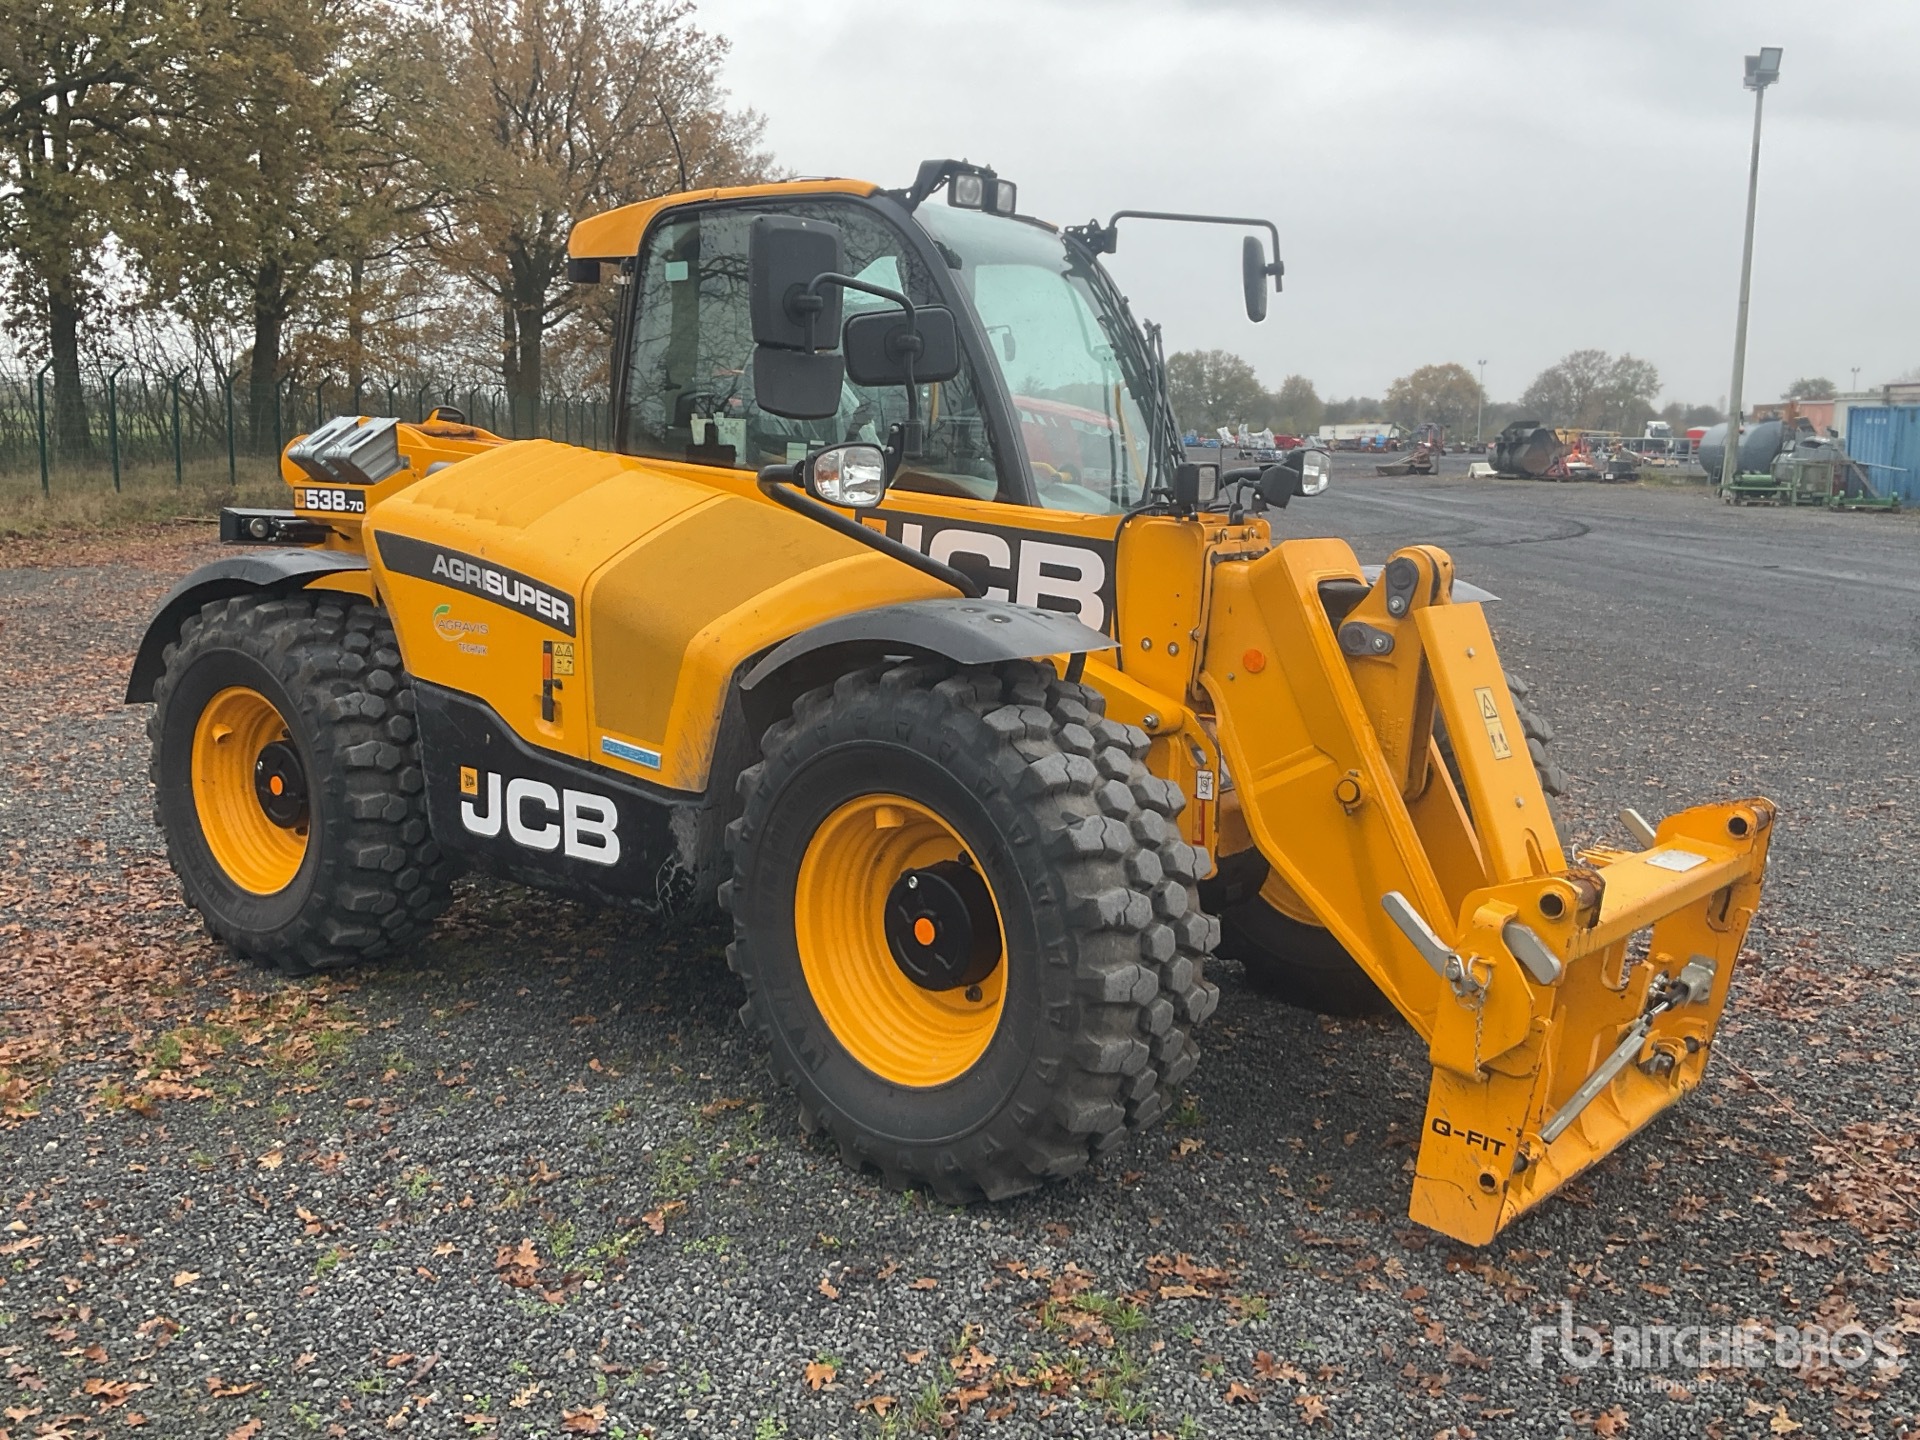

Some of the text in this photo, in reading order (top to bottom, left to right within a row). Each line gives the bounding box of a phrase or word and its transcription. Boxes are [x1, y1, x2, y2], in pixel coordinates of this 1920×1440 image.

[432, 554, 569, 627] AGRISUPER
[438, 619, 489, 634] AGRAVIS
[461, 772, 621, 865] JCB
[1431, 1117, 1507, 1156] Q-FIT
